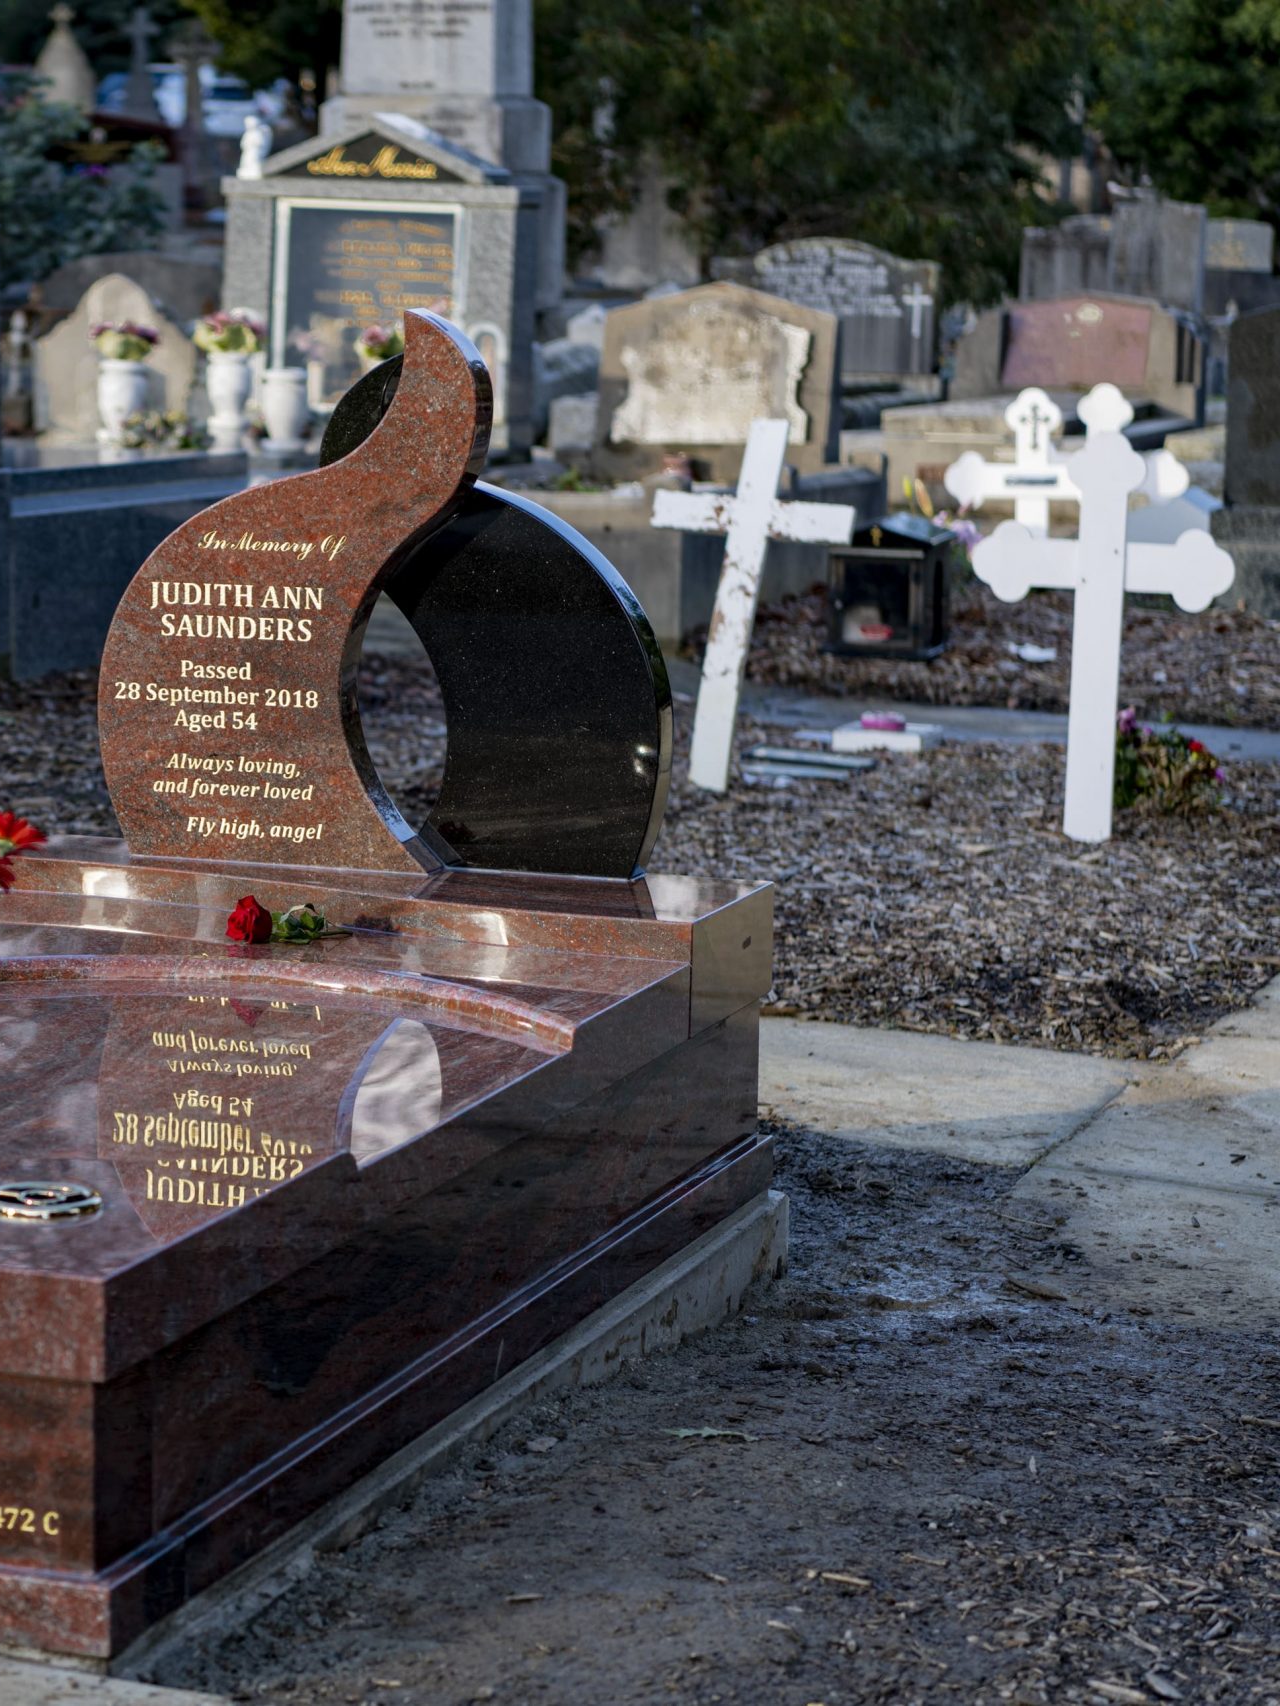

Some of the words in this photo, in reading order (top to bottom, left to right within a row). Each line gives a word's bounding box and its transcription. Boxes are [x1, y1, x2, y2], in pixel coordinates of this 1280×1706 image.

[197, 530, 229, 550] In
[231, 531, 317, 561] Memory
[320, 534, 348, 561] Of
[150, 581, 254, 610] JUDITH
[260, 586, 324, 611] ANN
[160, 613, 313, 642] SAUNDERS
[180, 660, 252, 681] Passed
[114, 682, 141, 701] 28
[146, 683, 260, 707] September
[264, 688, 319, 709] 2018
[174, 710, 226, 732] Aged
[231, 711, 258, 731] 54
[166, 753, 234, 775] Always
[238, 756, 301, 779] loving,
[153, 778, 188, 795] and
[189, 778, 260, 799] forever
[263, 782, 314, 801] loved
[186, 816, 216, 838] Fly
[219, 818, 265, 840] high,
[270, 823, 323, 843] angel
[43, 1510, 60, 1536] C
